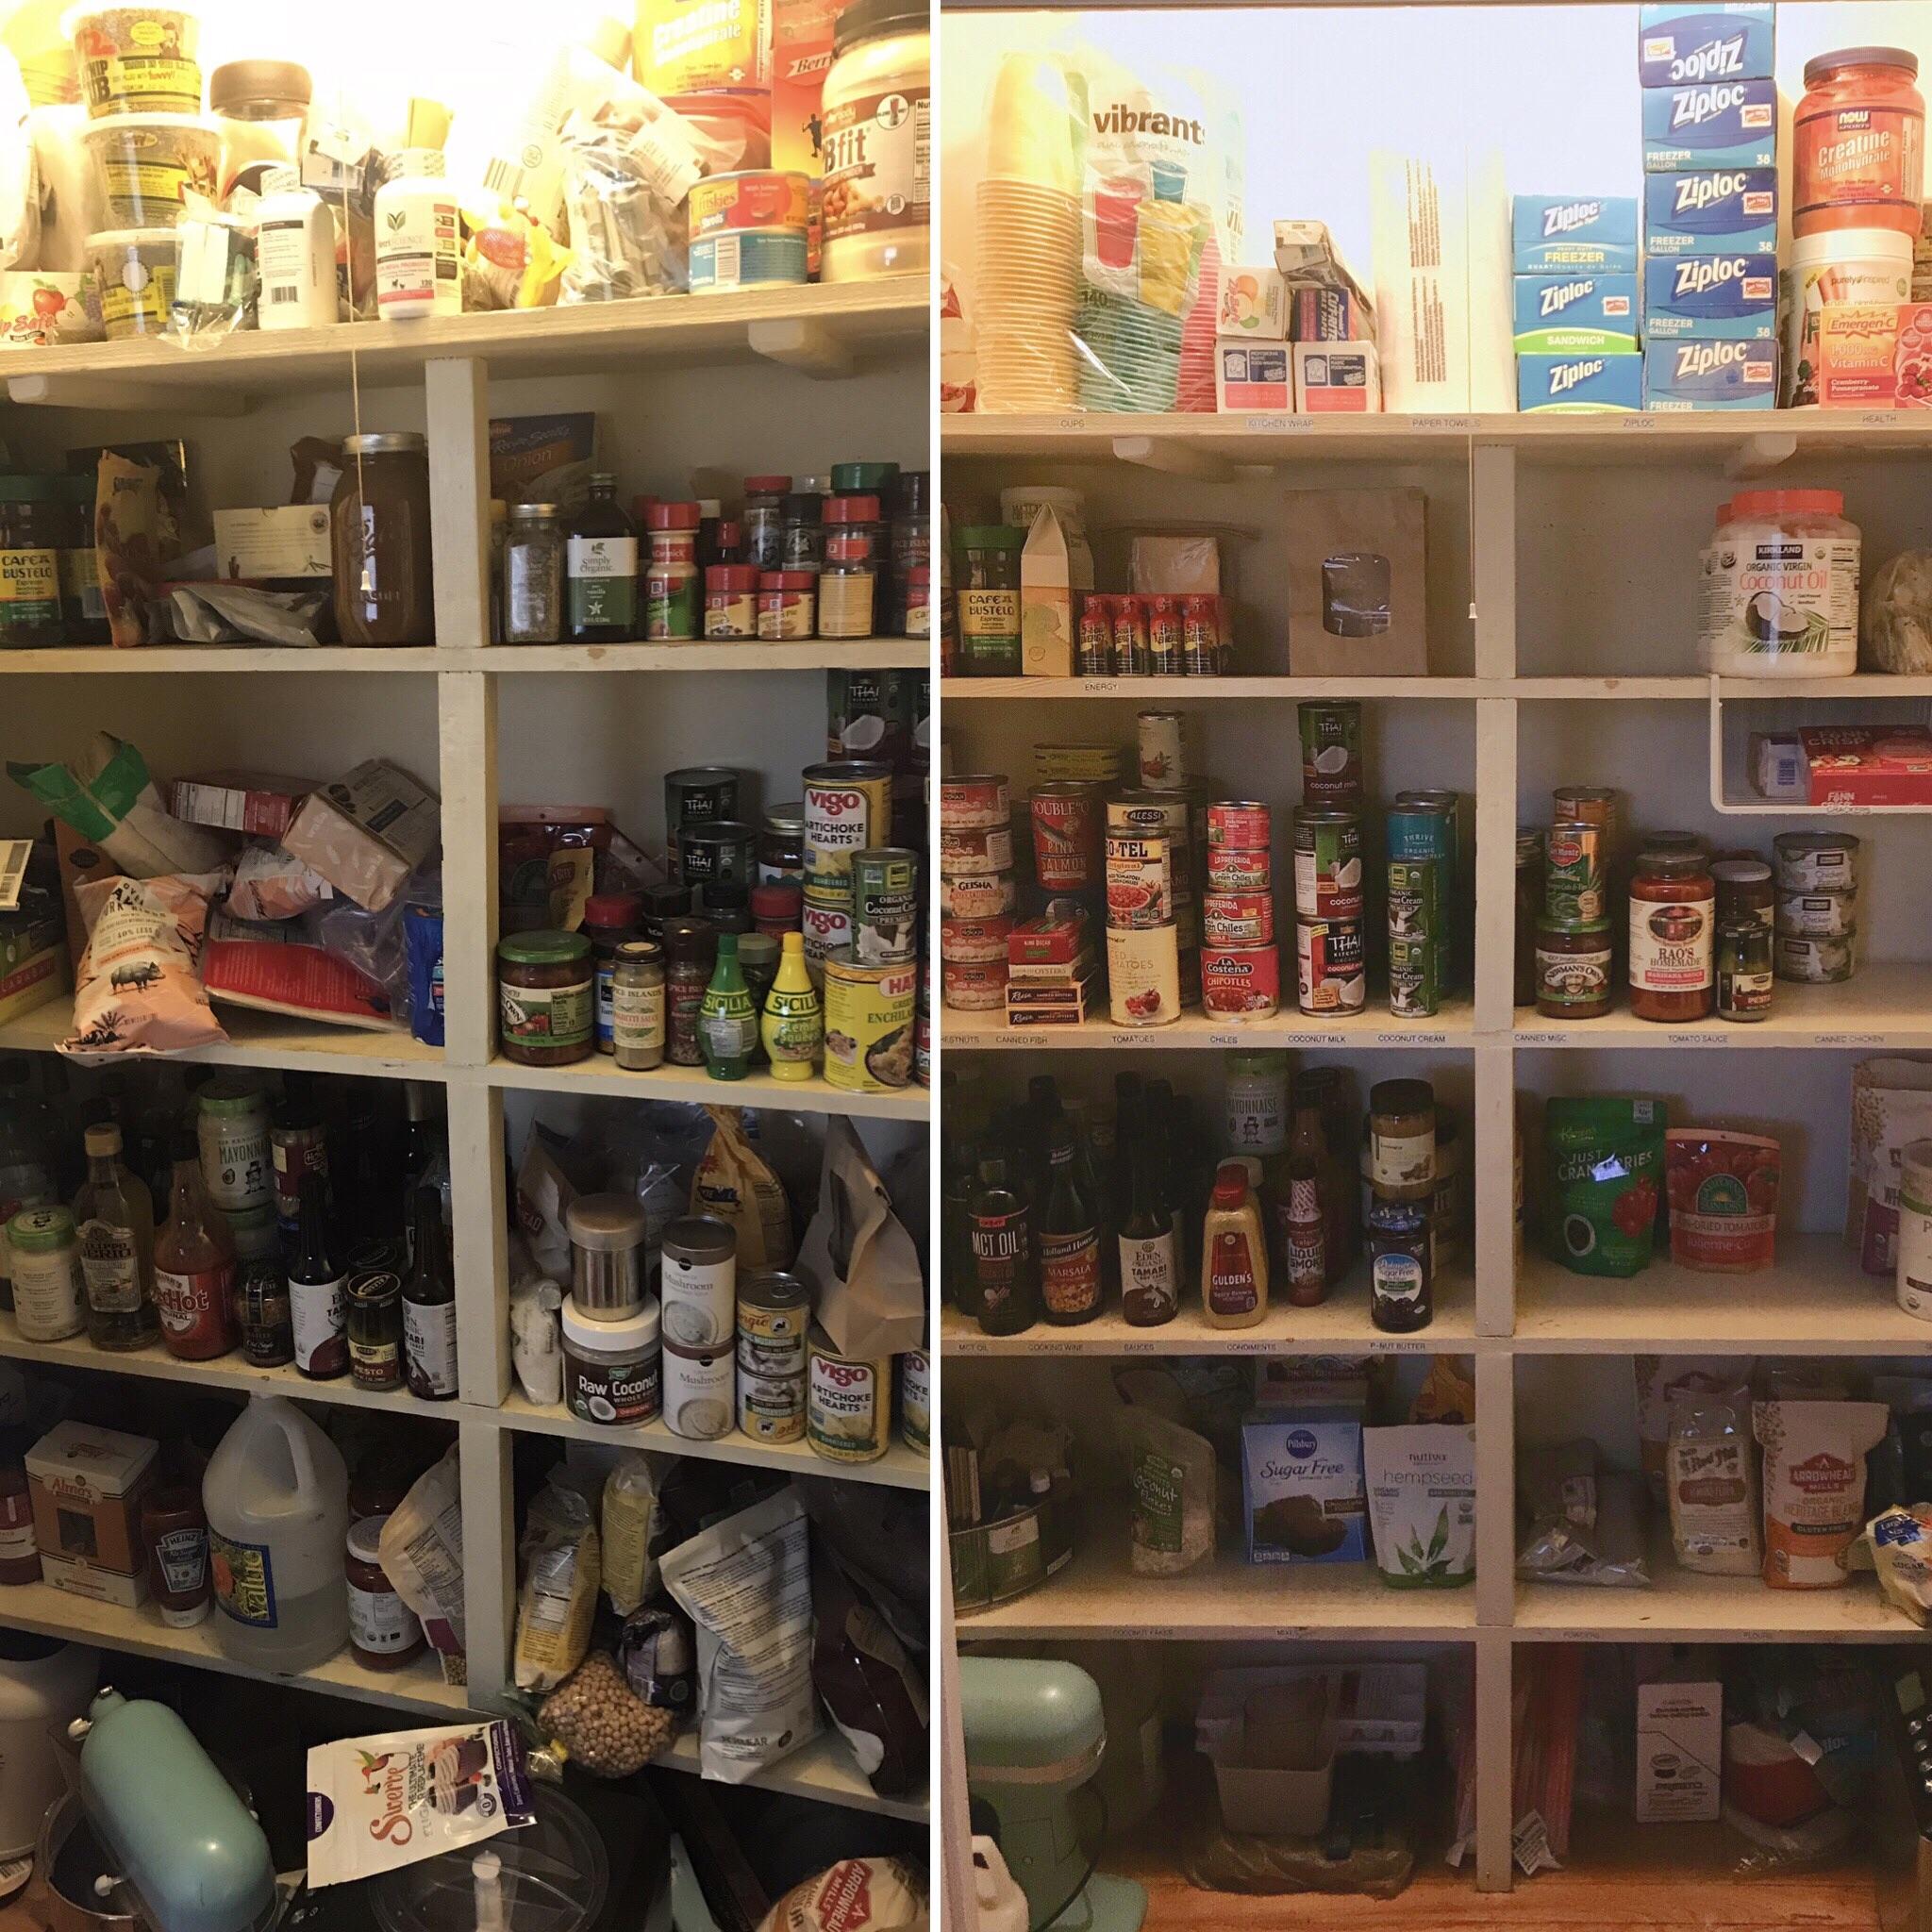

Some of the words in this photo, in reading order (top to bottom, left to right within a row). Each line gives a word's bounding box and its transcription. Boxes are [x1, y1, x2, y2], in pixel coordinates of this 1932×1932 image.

[1671, 37, 1744, 81] Ziploc
[1673, 85, 1746, 125] Ziploc
[1817, 130, 1890, 168] Creatine
[1645, 150, 1691, 161] FREEZER
[1756, 154, 1772, 166] 38
[1819, 150, 1891, 182] Monohydrate
[1675, 173, 1748, 212] Ziploc
[1543, 200, 1601, 237] Ziploc
[1649, 235, 1695, 246] FREEZER
[1757, 240, 1774, 253] 38
[1543, 251, 1606, 263] FREEZER
[1674, 258, 1747, 294] Ziploc
[1083, 290, 1108, 307] 140
[1540, 280, 1595, 318] Ziploc
[1648, 317, 1694, 328] FREEZER
[1756, 325, 1772, 338] 38
[1829, 316, 1895, 331] Emergen-C
[1546, 332, 1605, 342] SANDWICH
[1675, 341, 1747, 379] Ziploc
[1829, 356, 1869, 368] Vitamin
[1871, 356, 1889, 368] C
[1549, 360, 1604, 395] Ziploc
[1059, 420, 1085, 428] CUPS
[1247, 419, 1284, 428] KITCHEN
[1286, 419, 1314, 428] WRAP
[1411, 419, 1441, 427] PAPER
[1442, 419, 1481, 427] TOWELS
[1622, 419, 1655, 427] ZIPLOC
[1861, 414, 1898, 423] HEALTH
[1757, 546, 1803, 555] KIRKLAND
[1745, 562, 1782, 572] ORGANIC
[1782, 561, 1813, 571] VIRGIN
[1739, 571, 1805, 591] Coconut
[1807, 569, 1828, 590] Oil
[969, 595, 1001, 605] CAFE
[968, 606, 1015, 616] BUSTELO
[1084, 683, 1118, 691] ENERGY
[1320, 723, 1342, 734] THAI
[1309, 781, 1343, 791] coconut
[1128, 811, 1162, 821] ALESSI
[810, 831, 855, 845] HEARTS
[1047, 841, 1076, 854] PINK
[1041, 857, 1088, 873] SALMON
[1231, 874, 1252, 882] Chiles
[958, 880, 993, 891] GEISHA
[1400, 896, 1424, 906] Cream
[1216, 921, 1244, 933] Chiles
[1327, 936, 1361, 952] THAI
[1658, 947, 1695, 960] RAO'S
[1221, 958, 1232, 966] La
[1650, 957, 1704, 968] HOMEMADE
[1326, 963, 1357, 974] coconut
[1207, 975, 1252, 988] CHIPOTLES
[1402, 972, 1424, 981] Cream
[703, 994, 752, 1011] SICILIA
[995, 1036, 1029, 1044] CANNED
[1030, 1037, 1048, 1045] FISH
[1112, 1035, 1156, 1043] TOMATOES
[1209, 1036, 1239, 1044] CHILES
[1288, 1035, 1324, 1043] COCONUT
[1327, 1035, 1346, 1043] MILK
[1377, 1035, 1418, 1043] COCONUT
[1419, 1034, 1446, 1043] CREAM
[1514, 1034, 1546, 1043] CANNED
[1547, 1035, 1567, 1043] MISC
[1668, 1035, 1701, 1043] TOMATO
[1701, 1034, 1728, 1043] SAUCE
[1848, 1036, 1885, 1044] CHICKEN
[1568, 1149, 1603, 1166] JUST
[971, 1230, 994, 1257] MCT
[998, 1229, 1021, 1256] OIL
[1041, 1244, 1073, 1257] Holland
[1072, 1235, 1094, 1251] House
[1136, 1251, 1161, 1261] EDEN
[1047, 1264, 1091, 1278] MARSALA
[1131, 1264, 1168, 1276] TAMARI
[1211, 1271, 1253, 1286] GULDEN'S
[1027, 1343, 1063, 1352] COOKING
[1063, 1343, 1083, 1352] WINE
[1226, 1343, 1277, 1352] CONDIMENTS
[1370, 1341, 1394, 1351] P-NUT
[1395, 1341, 1425, 1351] BUTTER
[577, 1374, 608, 1397] Raw
[611, 1368, 659, 1397] Coconut
[812, 1382, 873, 1403] ARTICHOKE
[817, 1394, 861, 1413] HEARTS
[1286, 1438, 1316, 1450] Pillsbury
[1407, 1453, 1448, 1463] nutiva
[1259, 1460, 1310, 1480] Sugar
[1310, 1457, 1346, 1474] Free
[1383, 1469, 1473, 1487] hempseed
[1791, 1470, 1856, 1482] ARROWHEAD
[169, 1531, 197, 1545] HEINZ
[1891, 1560, 1925, 1571] SUGAR
[823, 1874, 843, 1911] MILLS
